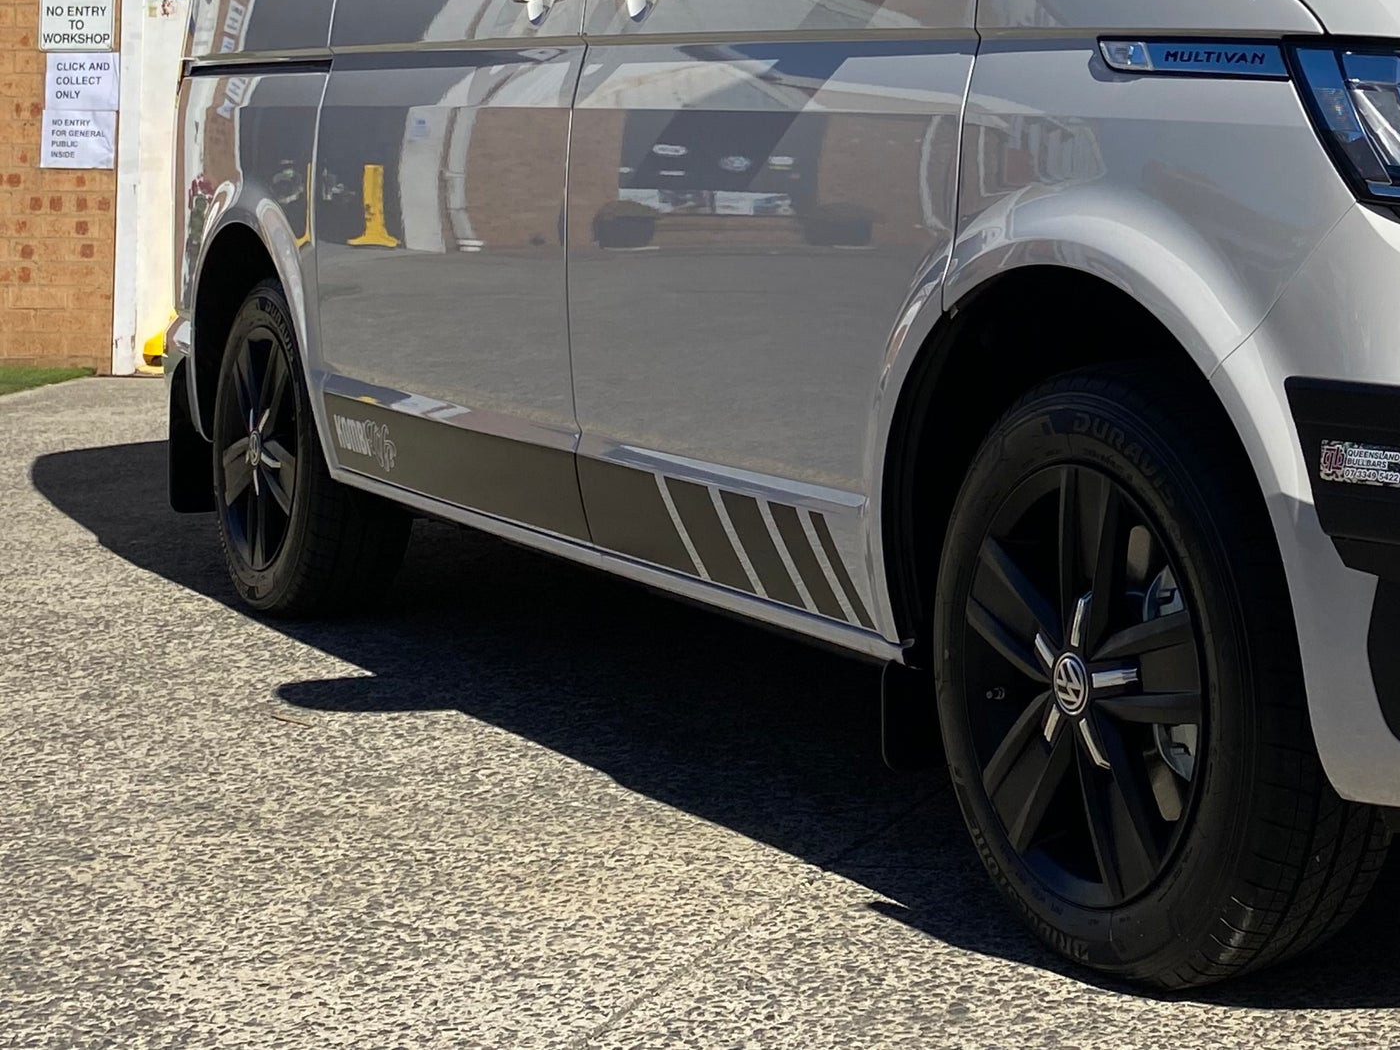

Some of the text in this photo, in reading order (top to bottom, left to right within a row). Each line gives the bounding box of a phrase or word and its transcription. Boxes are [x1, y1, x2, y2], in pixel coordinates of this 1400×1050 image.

[46, 6, 107, 17] NO ENTRY
[68, 19, 85, 30] TO
[43, 33, 111, 44] WORKSHOP
[1164, 50, 1266, 66] MULTIVAN
[56, 62, 110, 71] CLICK AND
[56, 76, 102, 86] COLLECT
[55, 90, 81, 100] ONLY
[51, 129, 105, 137] FOR GENERAL
[51, 140, 79, 148] PUBLIC
[50, 151, 75, 159] INSIDE
[333, 414, 372, 457] KOMBI
[1347, 449, 1400, 461] QUEENSLAND
[1346, 457, 1387, 470] BULLBARS
[1379, 472, 1400, 482] 5422
